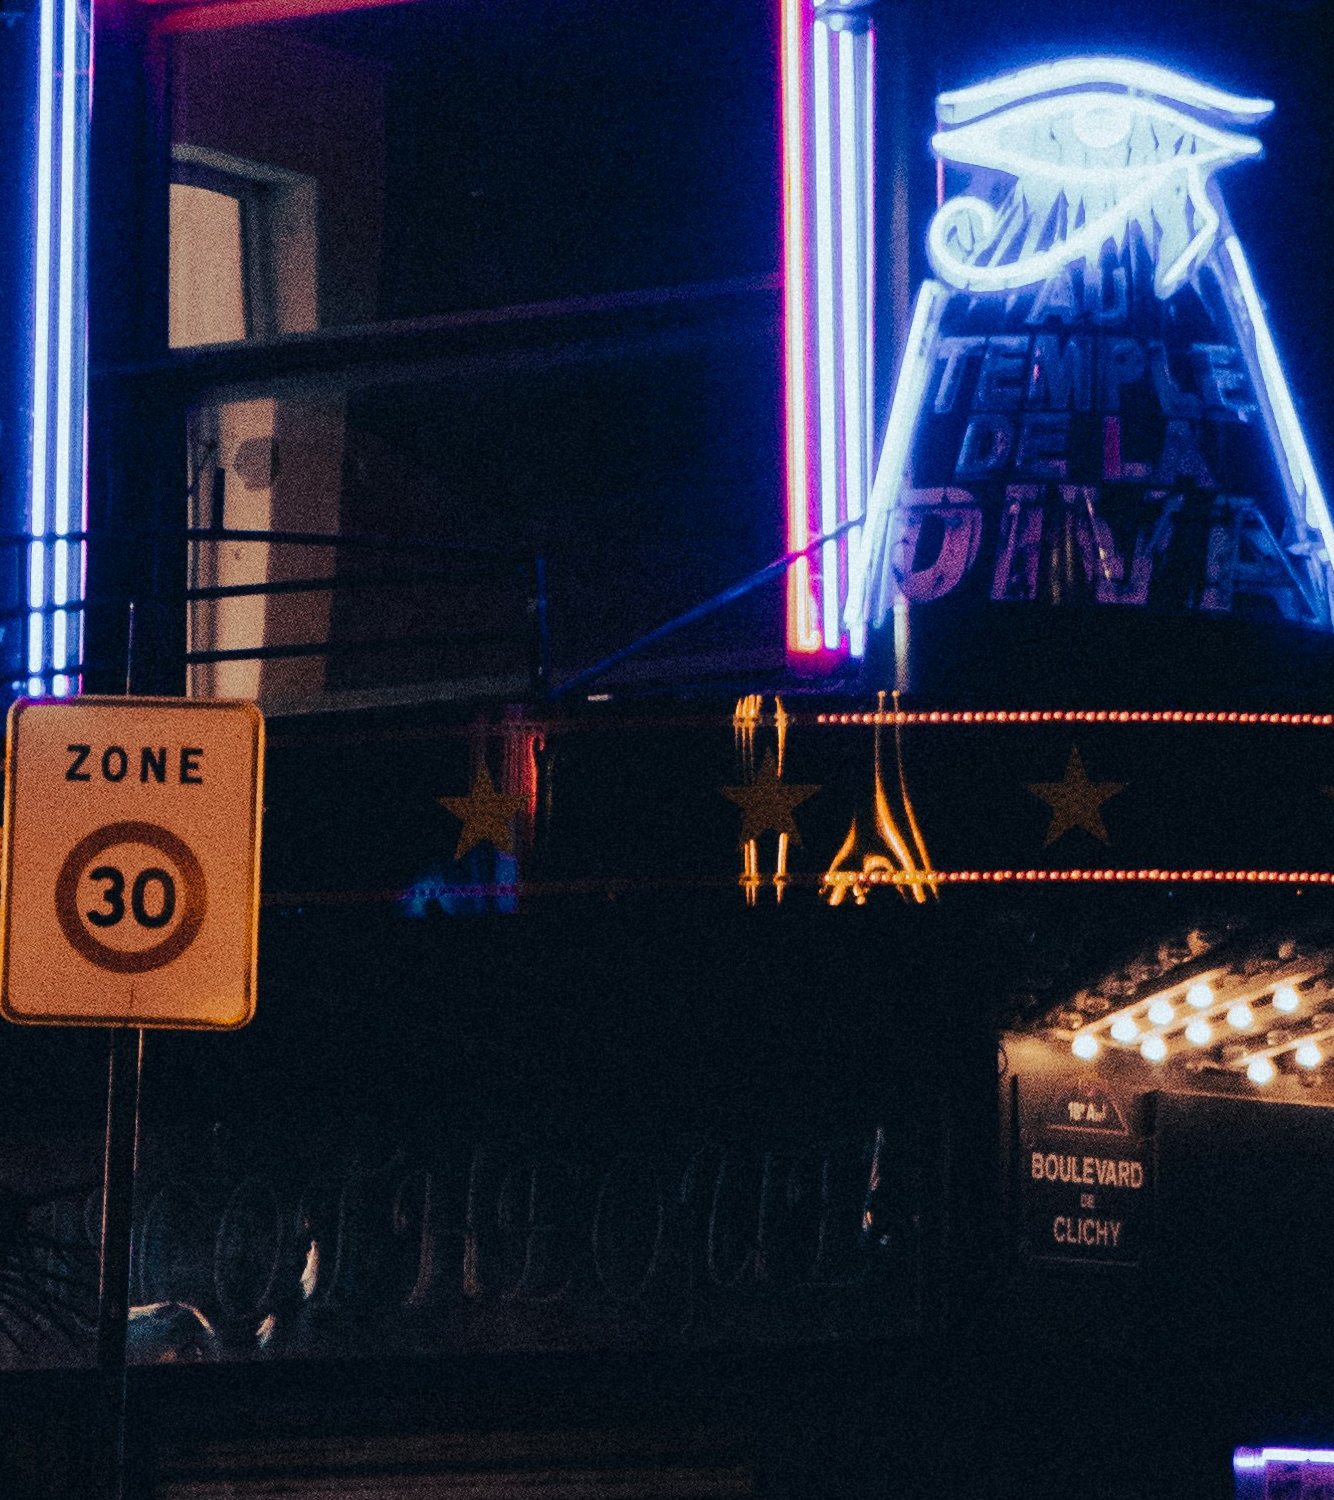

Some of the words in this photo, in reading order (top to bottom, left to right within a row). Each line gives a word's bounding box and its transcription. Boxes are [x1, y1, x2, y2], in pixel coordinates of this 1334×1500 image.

[933, 333, 1259, 423] TEMPLE
[955, 411, 1072, 483] DE
[1104, 414, 1216, 489] LA
[895, 483, 1328, 627] DIVA
[67, 744, 205, 784] ZONE
[86, 867, 176, 928] 30
[1031, 1152, 1144, 1189] BOULEVARD
[1053, 1215, 1123, 1247] CLICHY
